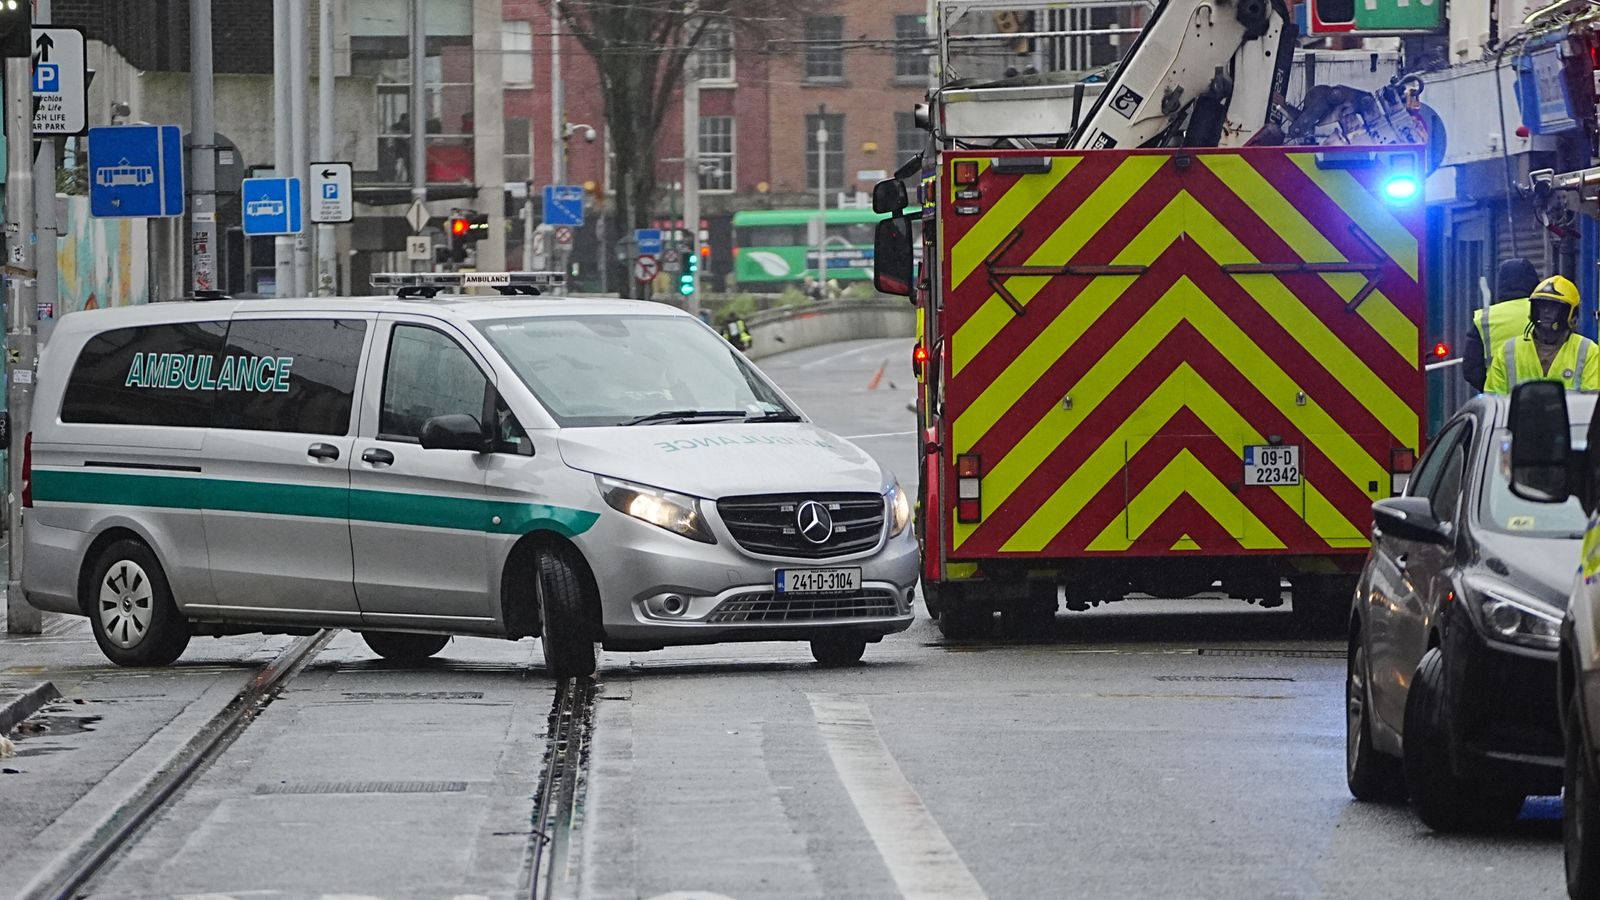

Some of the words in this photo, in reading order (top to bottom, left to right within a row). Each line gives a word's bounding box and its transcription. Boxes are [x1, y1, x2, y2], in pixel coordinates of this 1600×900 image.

[38, 67, 55, 89] P
[49, 113, 66, 121] LIFE
[45, 123, 66, 131] PARK
[326, 185, 336, 198] P
[412, 242, 427, 254] 15
[124, 352, 294, 393] AMBULANCE
[1262, 450, 1292, 466] 09-D
[1257, 467, 1297, 483] 22342
[792, 572, 853, 591] 241-D-3104
